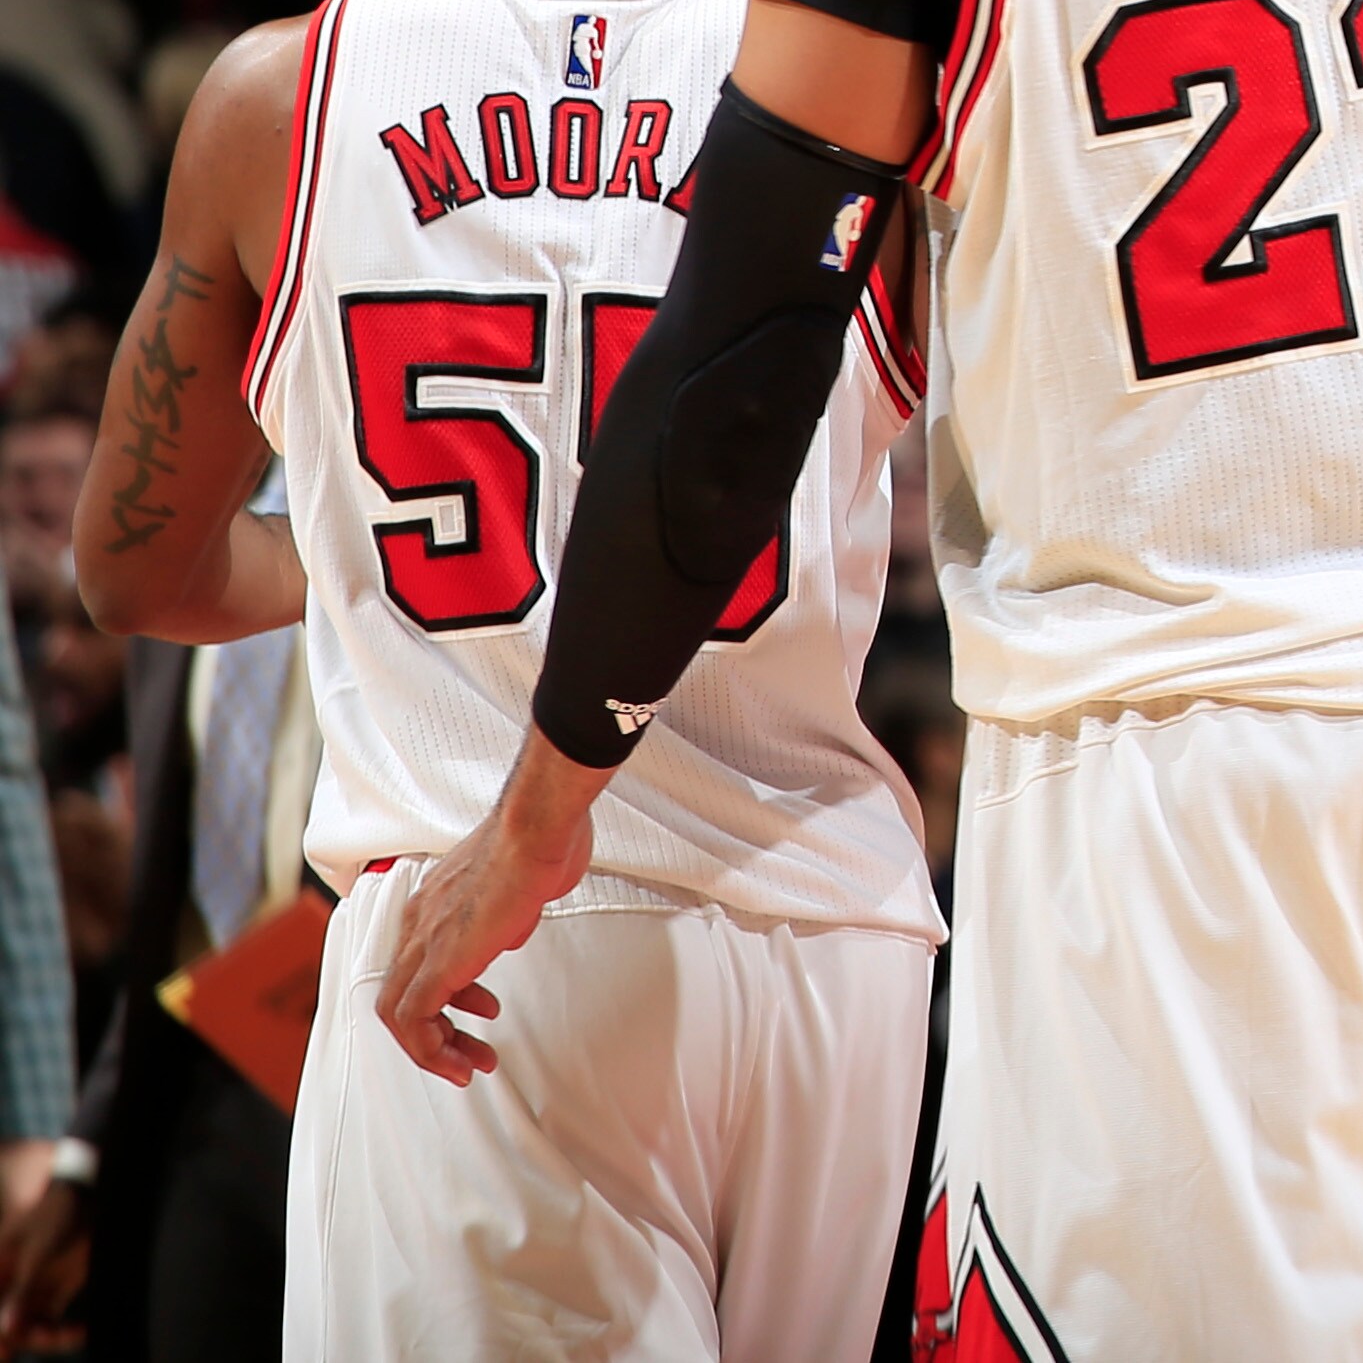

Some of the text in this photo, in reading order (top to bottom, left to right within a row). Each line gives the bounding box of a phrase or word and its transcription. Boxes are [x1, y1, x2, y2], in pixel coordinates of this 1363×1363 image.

[567, 72, 591, 87] NBA
[380, 93, 695, 226] MOOR
[339, 291, 792, 643] 5
